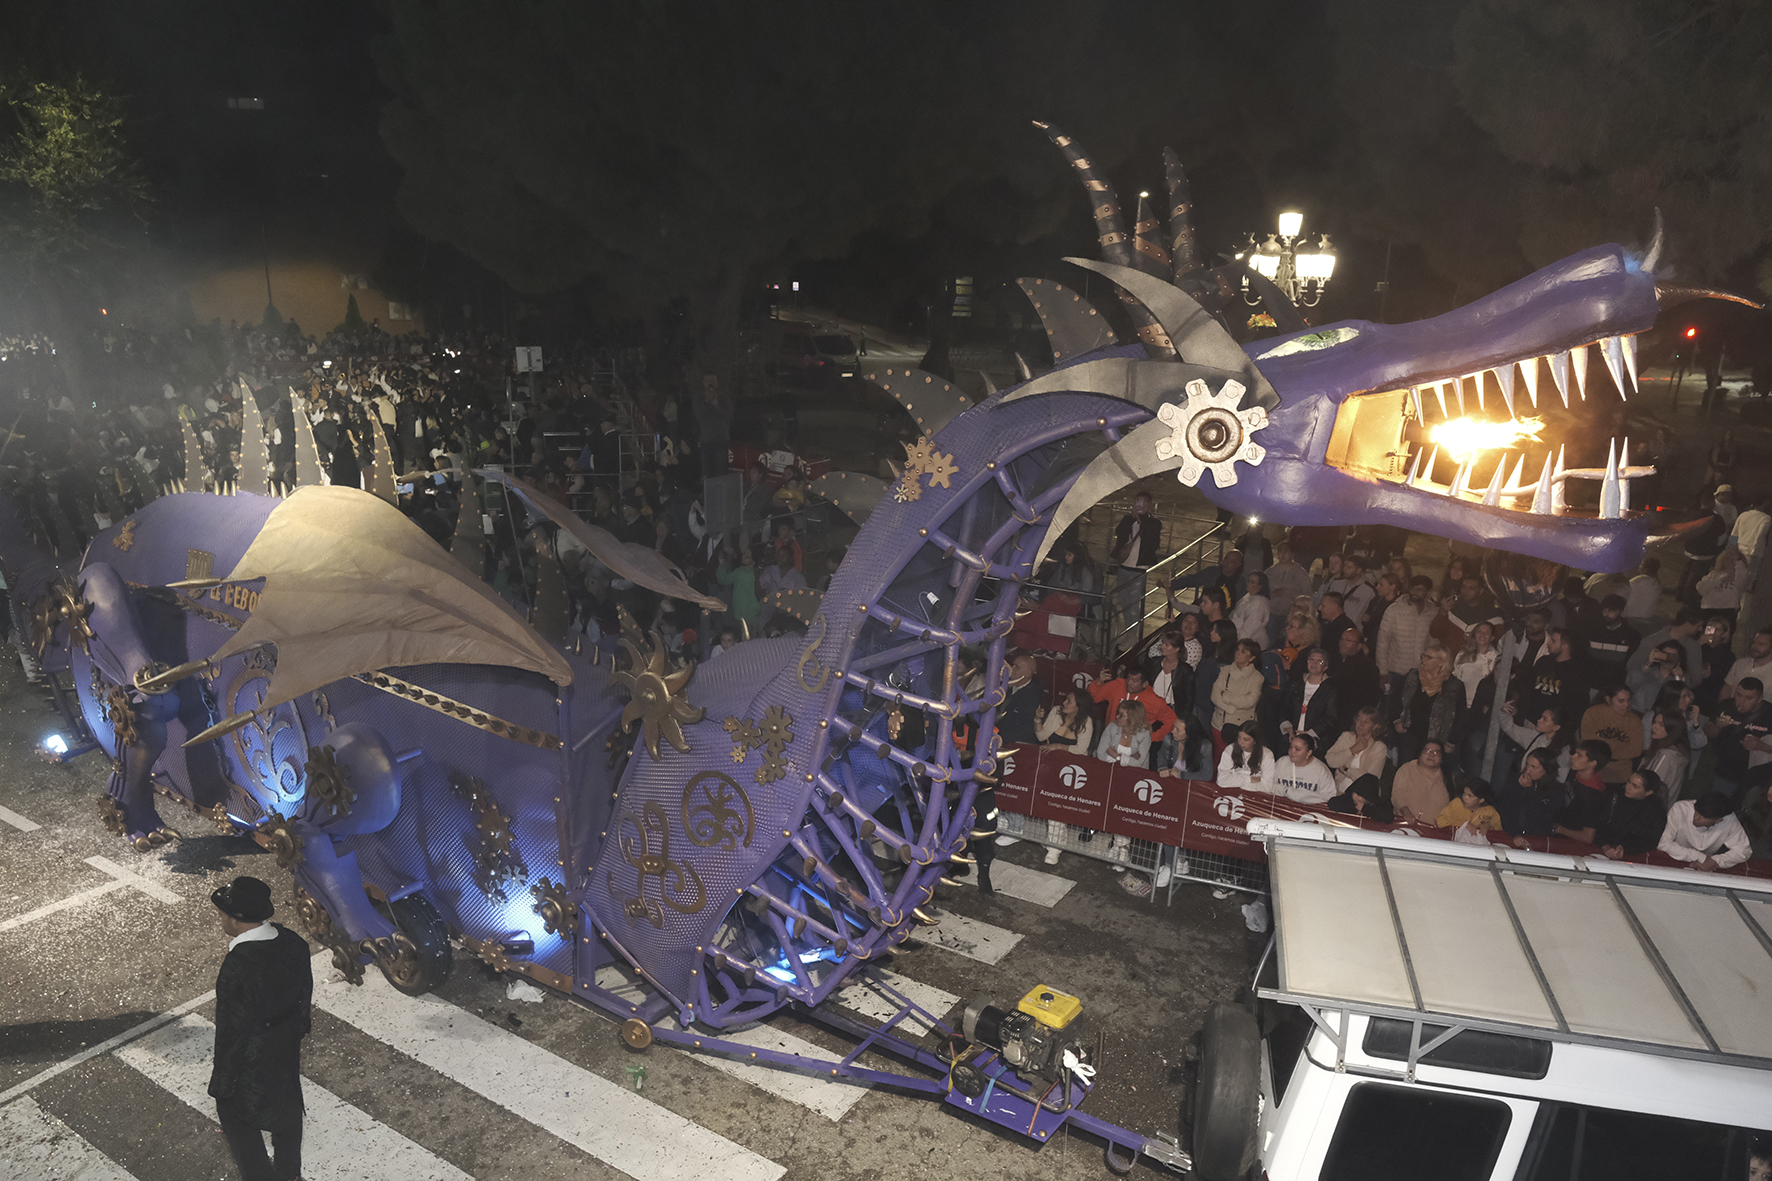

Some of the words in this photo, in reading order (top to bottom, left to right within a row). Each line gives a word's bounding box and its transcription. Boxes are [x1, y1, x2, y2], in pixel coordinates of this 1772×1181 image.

[1006, 783, 1029, 792] Henares
[1040, 790, 1068, 800] Azuqueca
[1077, 797, 1101, 806] Henares
[1113, 804, 1143, 815] Azuqueca
[1152, 812, 1178, 822] Henares
[1192, 820, 1224, 830] Azuqueca
